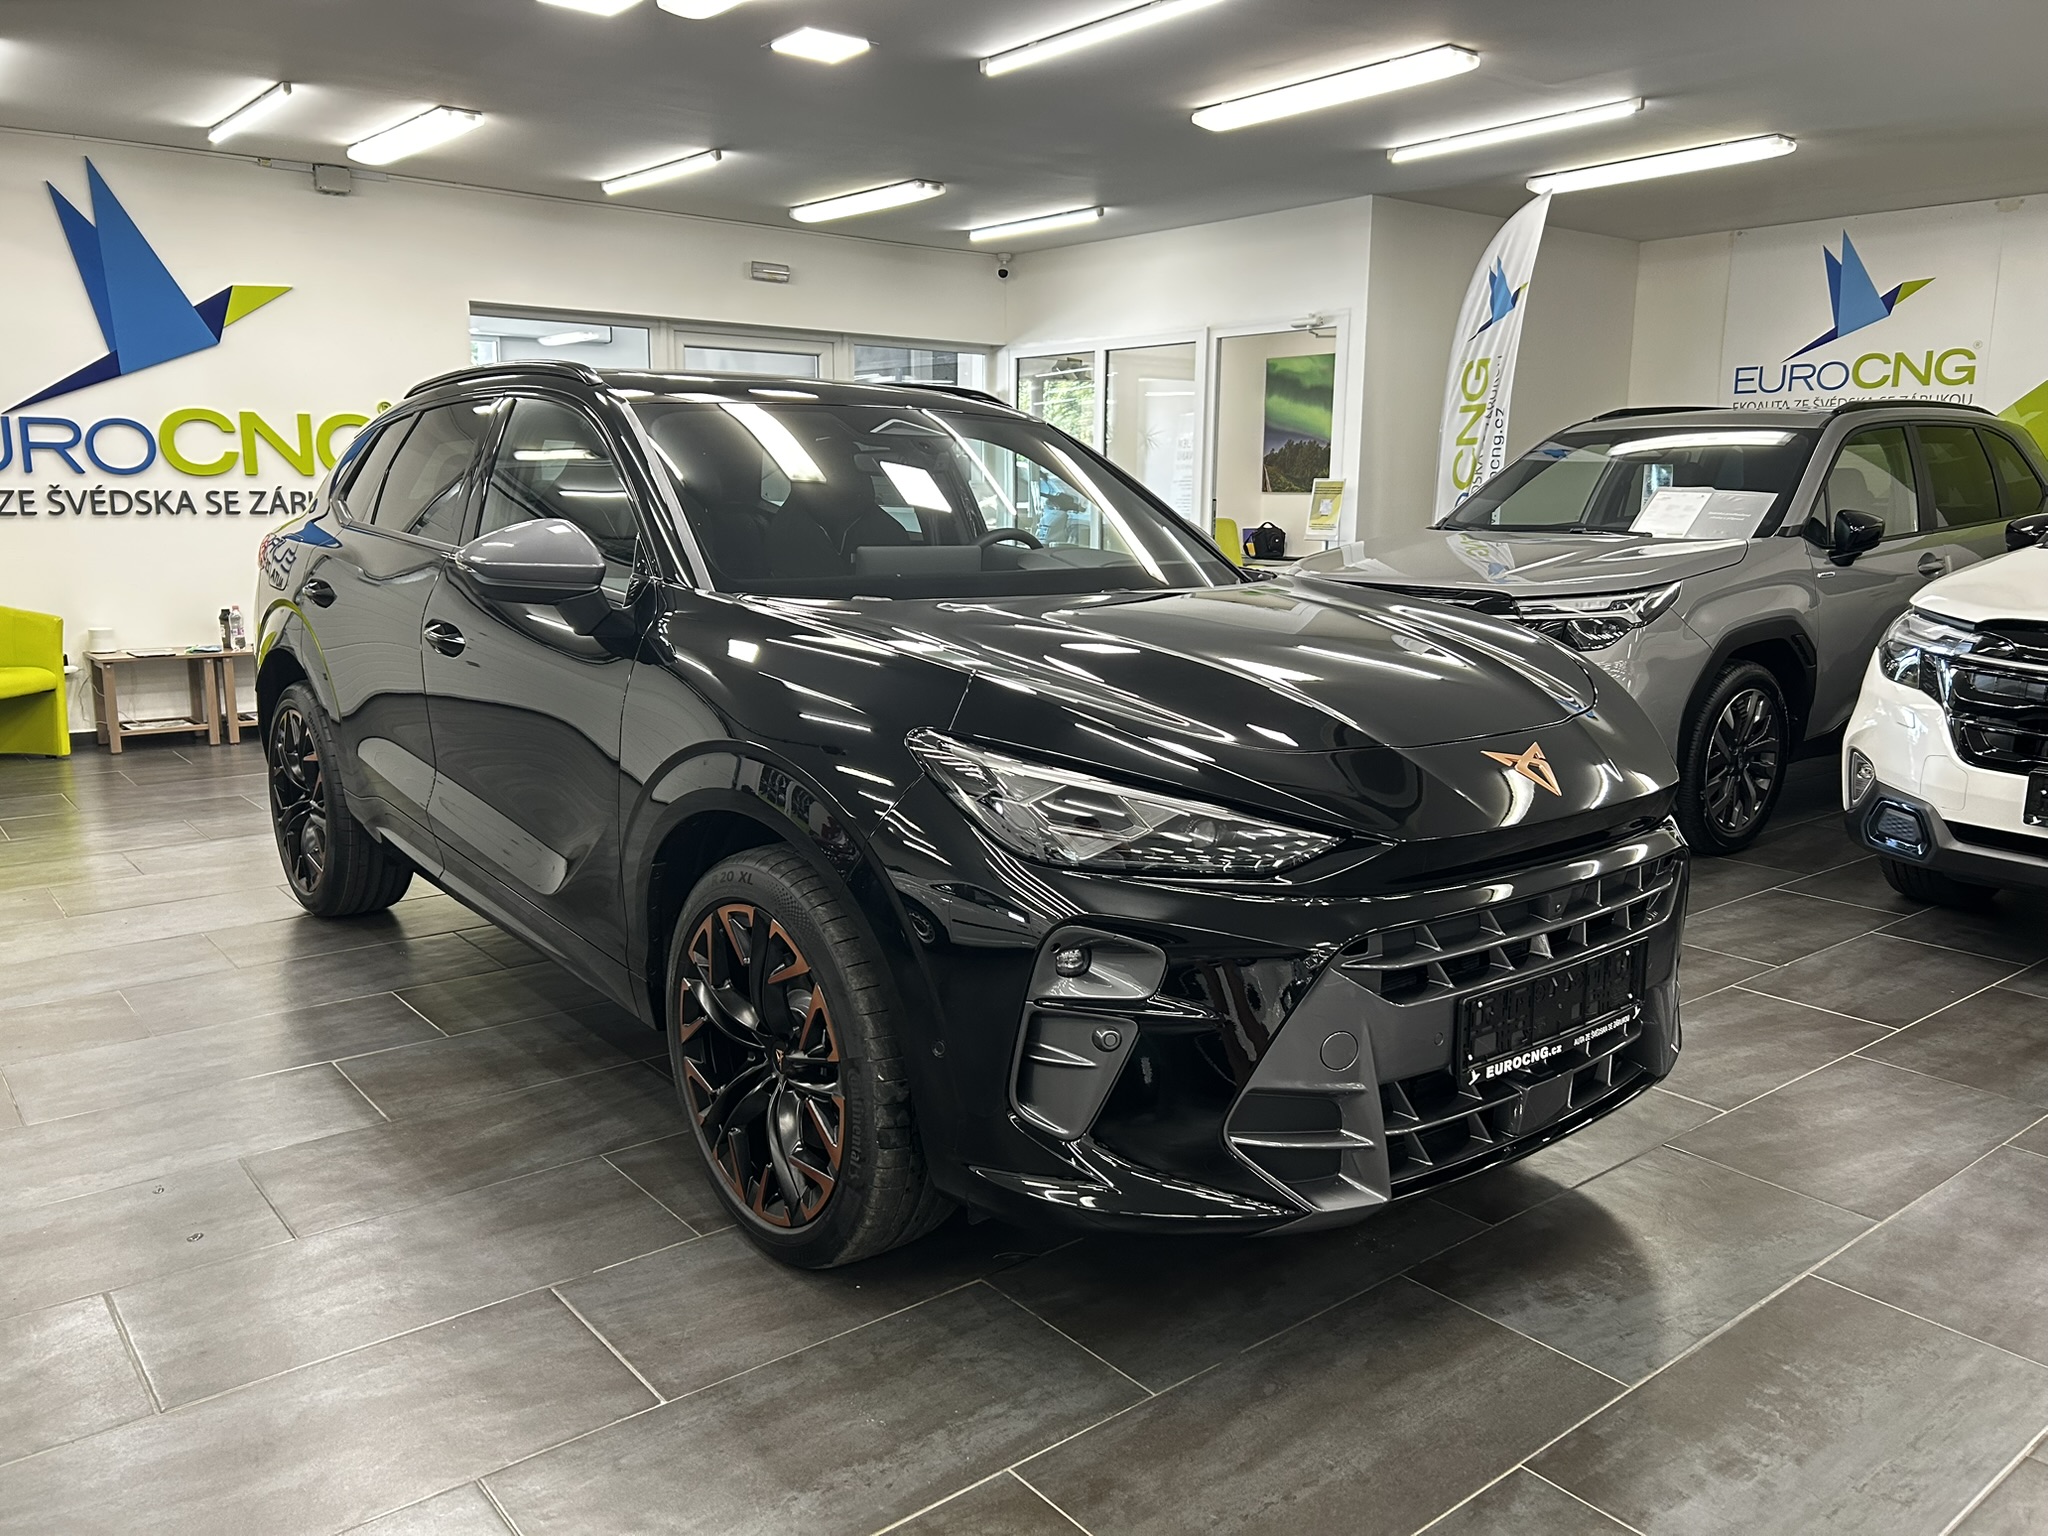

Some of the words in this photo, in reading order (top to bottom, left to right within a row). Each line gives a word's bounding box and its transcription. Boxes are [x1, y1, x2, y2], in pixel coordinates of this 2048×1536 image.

[1733, 347, 1977, 395] EUROCNG
[47, 484, 198, 516] ŠVÉDSKA
[206, 489, 242, 516] SE
[249, 486, 314, 516] ZÁR
[1485, 1045, 1563, 1079] EUROCNG.cz
